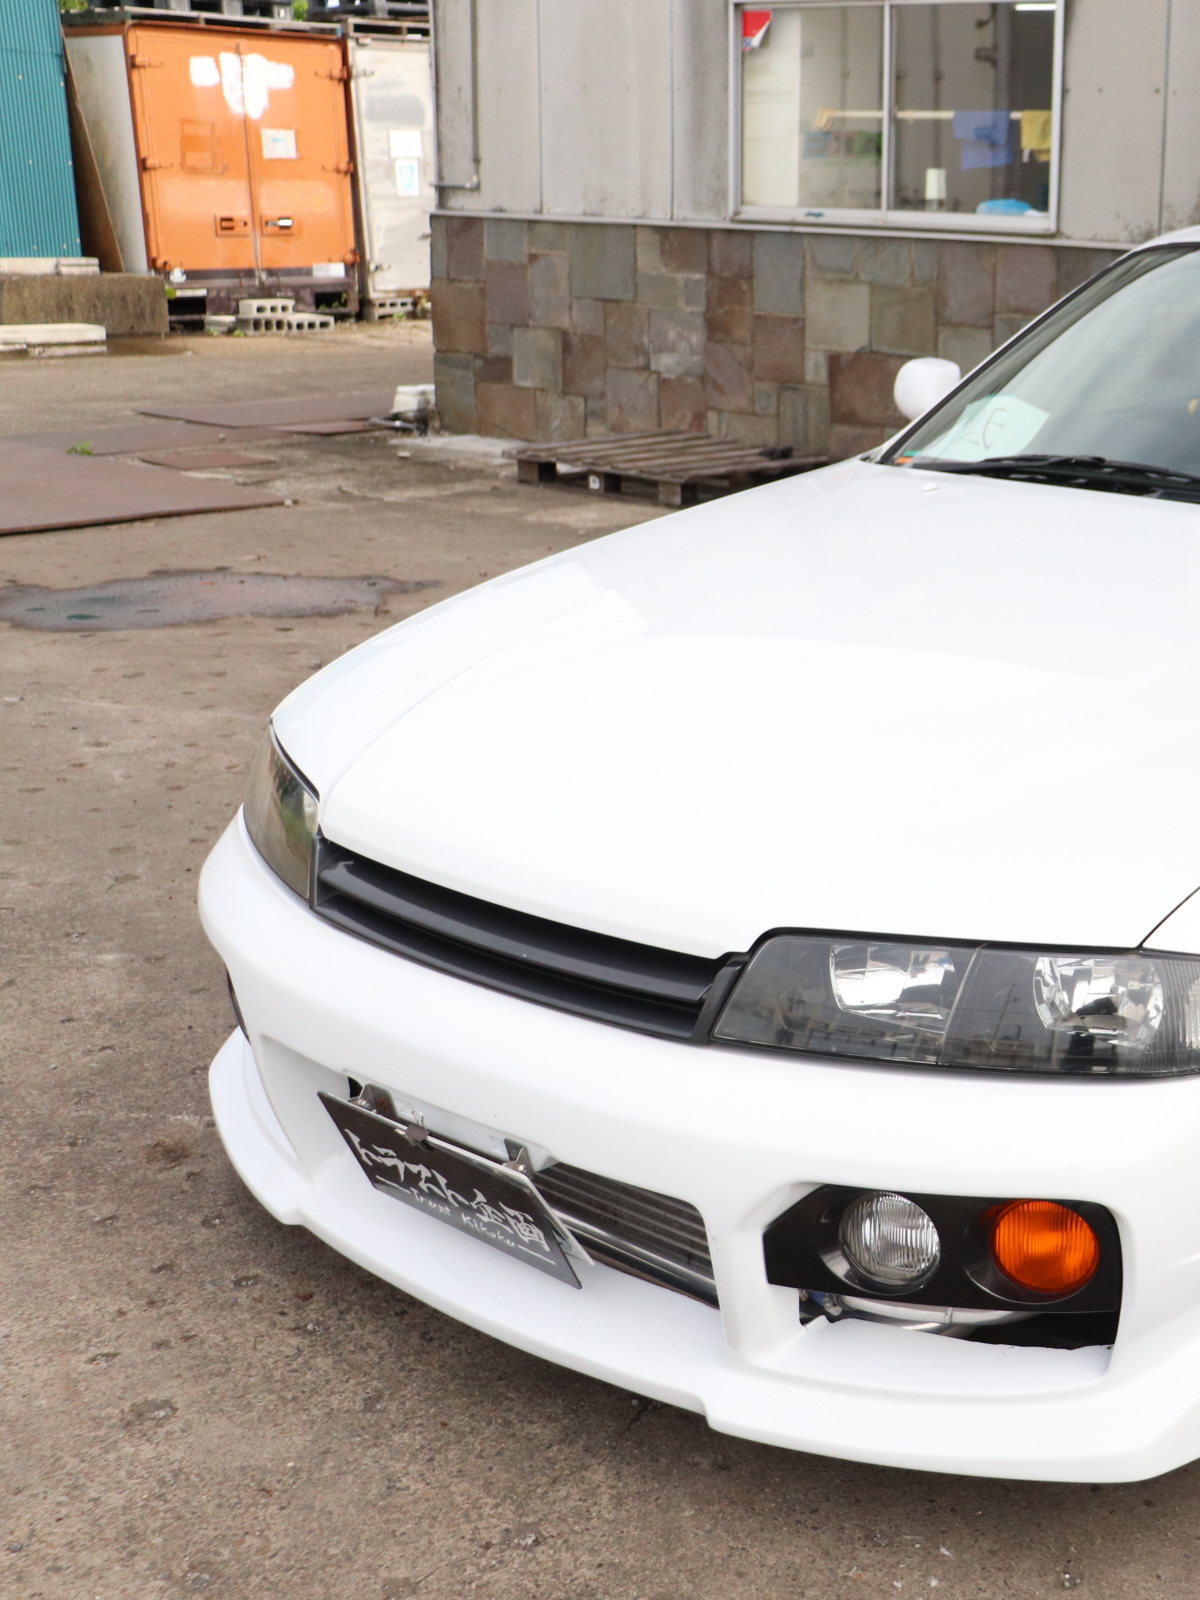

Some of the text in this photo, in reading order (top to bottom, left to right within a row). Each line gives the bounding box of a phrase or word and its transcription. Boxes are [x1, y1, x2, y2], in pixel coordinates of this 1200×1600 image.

[344, 1129, 550, 1251] トラスト企画
[410, 1187, 451, 1216] Trust
